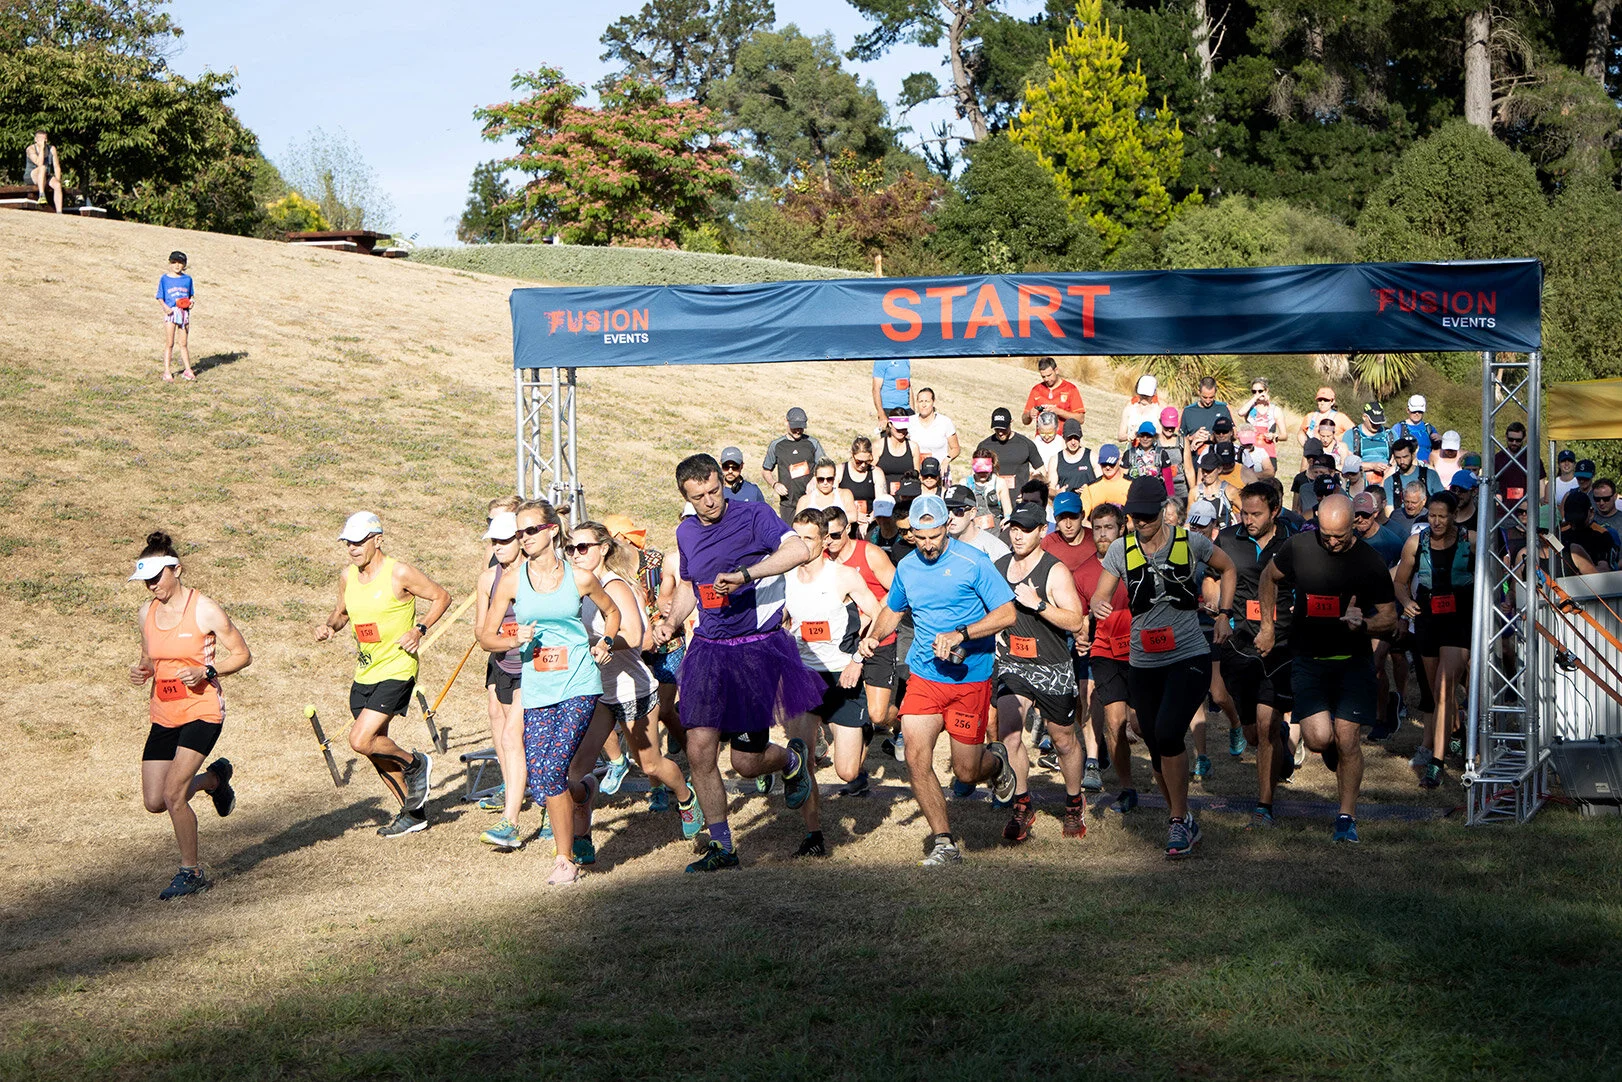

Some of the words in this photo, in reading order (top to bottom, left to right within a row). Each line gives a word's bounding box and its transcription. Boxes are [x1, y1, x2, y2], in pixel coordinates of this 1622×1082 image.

[1374, 287, 1497, 315] FUSION
[880, 283, 1111, 343] START
[544, 308, 649, 335] FUSION
[1442, 317, 1497, 328] EVENTS
[603, 333, 649, 344] EVENTS
[360, 629, 374, 637] 158
[808, 627, 824, 635] 129
[1149, 635, 1167, 645] 569
[1015, 643, 1029, 651] 534
[542, 654, 560, 663] 627
[162, 685, 178, 694] 491
[954, 718, 971, 729] 256
